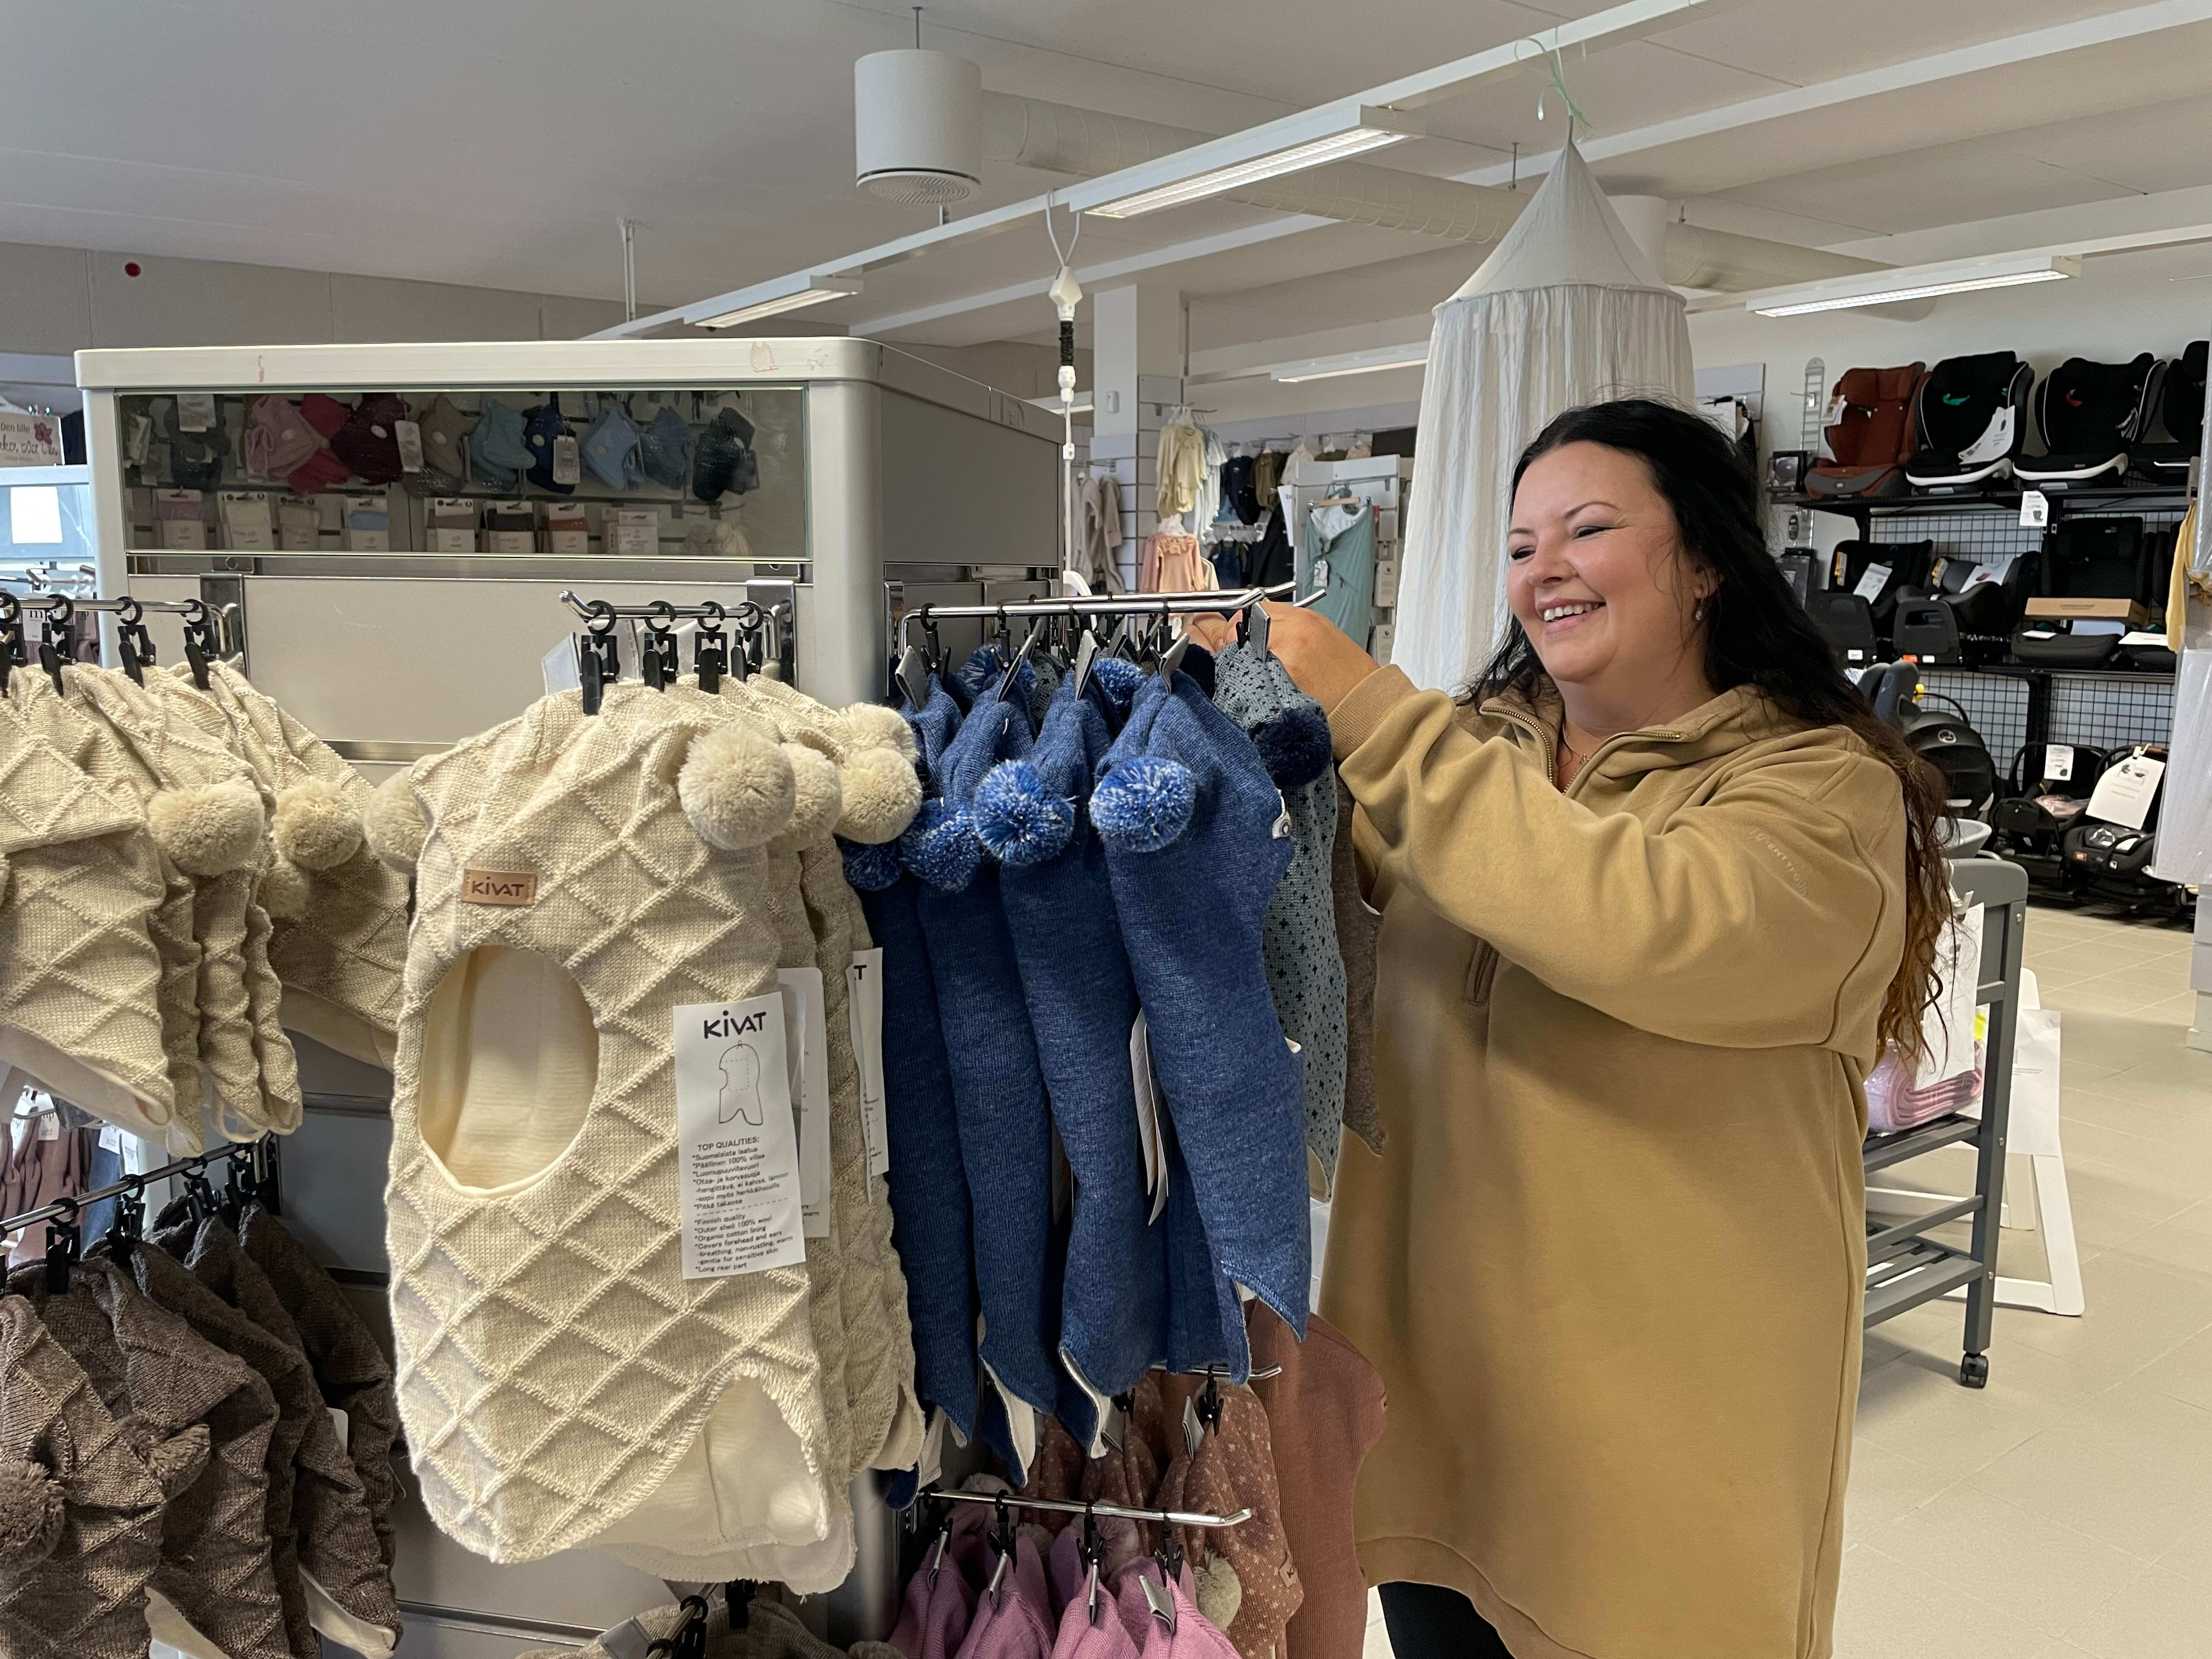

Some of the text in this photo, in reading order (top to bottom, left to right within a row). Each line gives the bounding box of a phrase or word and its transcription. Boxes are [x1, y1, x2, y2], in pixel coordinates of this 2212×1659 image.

[697, 1136, 760, 1152] TOP QUALITIES:
[729, 1155, 747, 1164] 100%
[724, 1214, 746, 1222] quality
[738, 1218, 755, 1227] 100%
[758, 1214, 772, 1223] wool
[724, 1235, 754, 1246] forehead
[756, 1232, 767, 1240] and
[736, 1251, 764, 1261] sensitive
